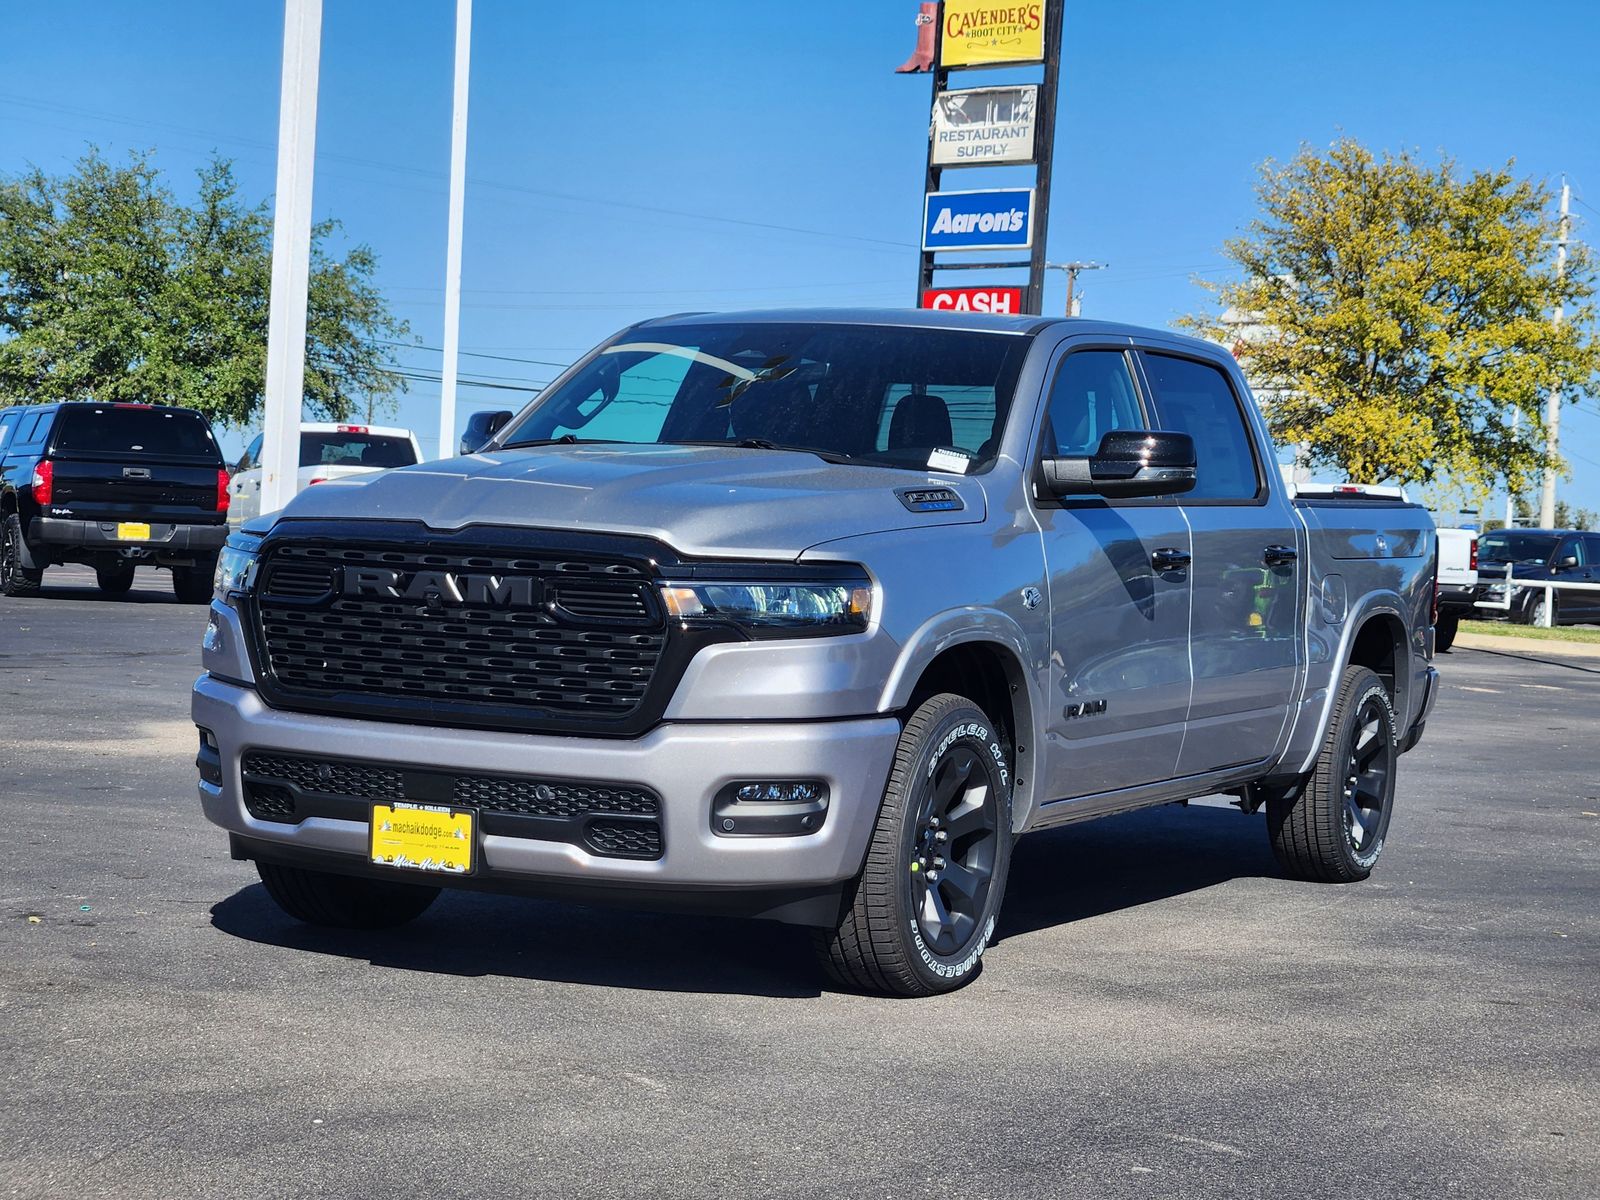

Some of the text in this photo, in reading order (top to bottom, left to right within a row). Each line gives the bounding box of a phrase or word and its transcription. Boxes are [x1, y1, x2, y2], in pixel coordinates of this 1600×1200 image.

[947, 4, 1040, 38] CAVENDER'S
[970, 25, 1018, 38] BOOT CITY
[939, 126, 1029, 142] RESTAURANT
[956, 144, 1008, 157] SUPPLY
[931, 207, 1024, 234] Aaron's
[932, 292, 1011, 315] CASH
[343, 565, 533, 606] RAM
[1063, 700, 1107, 717] RAM
[392, 821, 453, 839] machaikdodge.com
[910, 915, 995, 977] BRIDGESTONE
